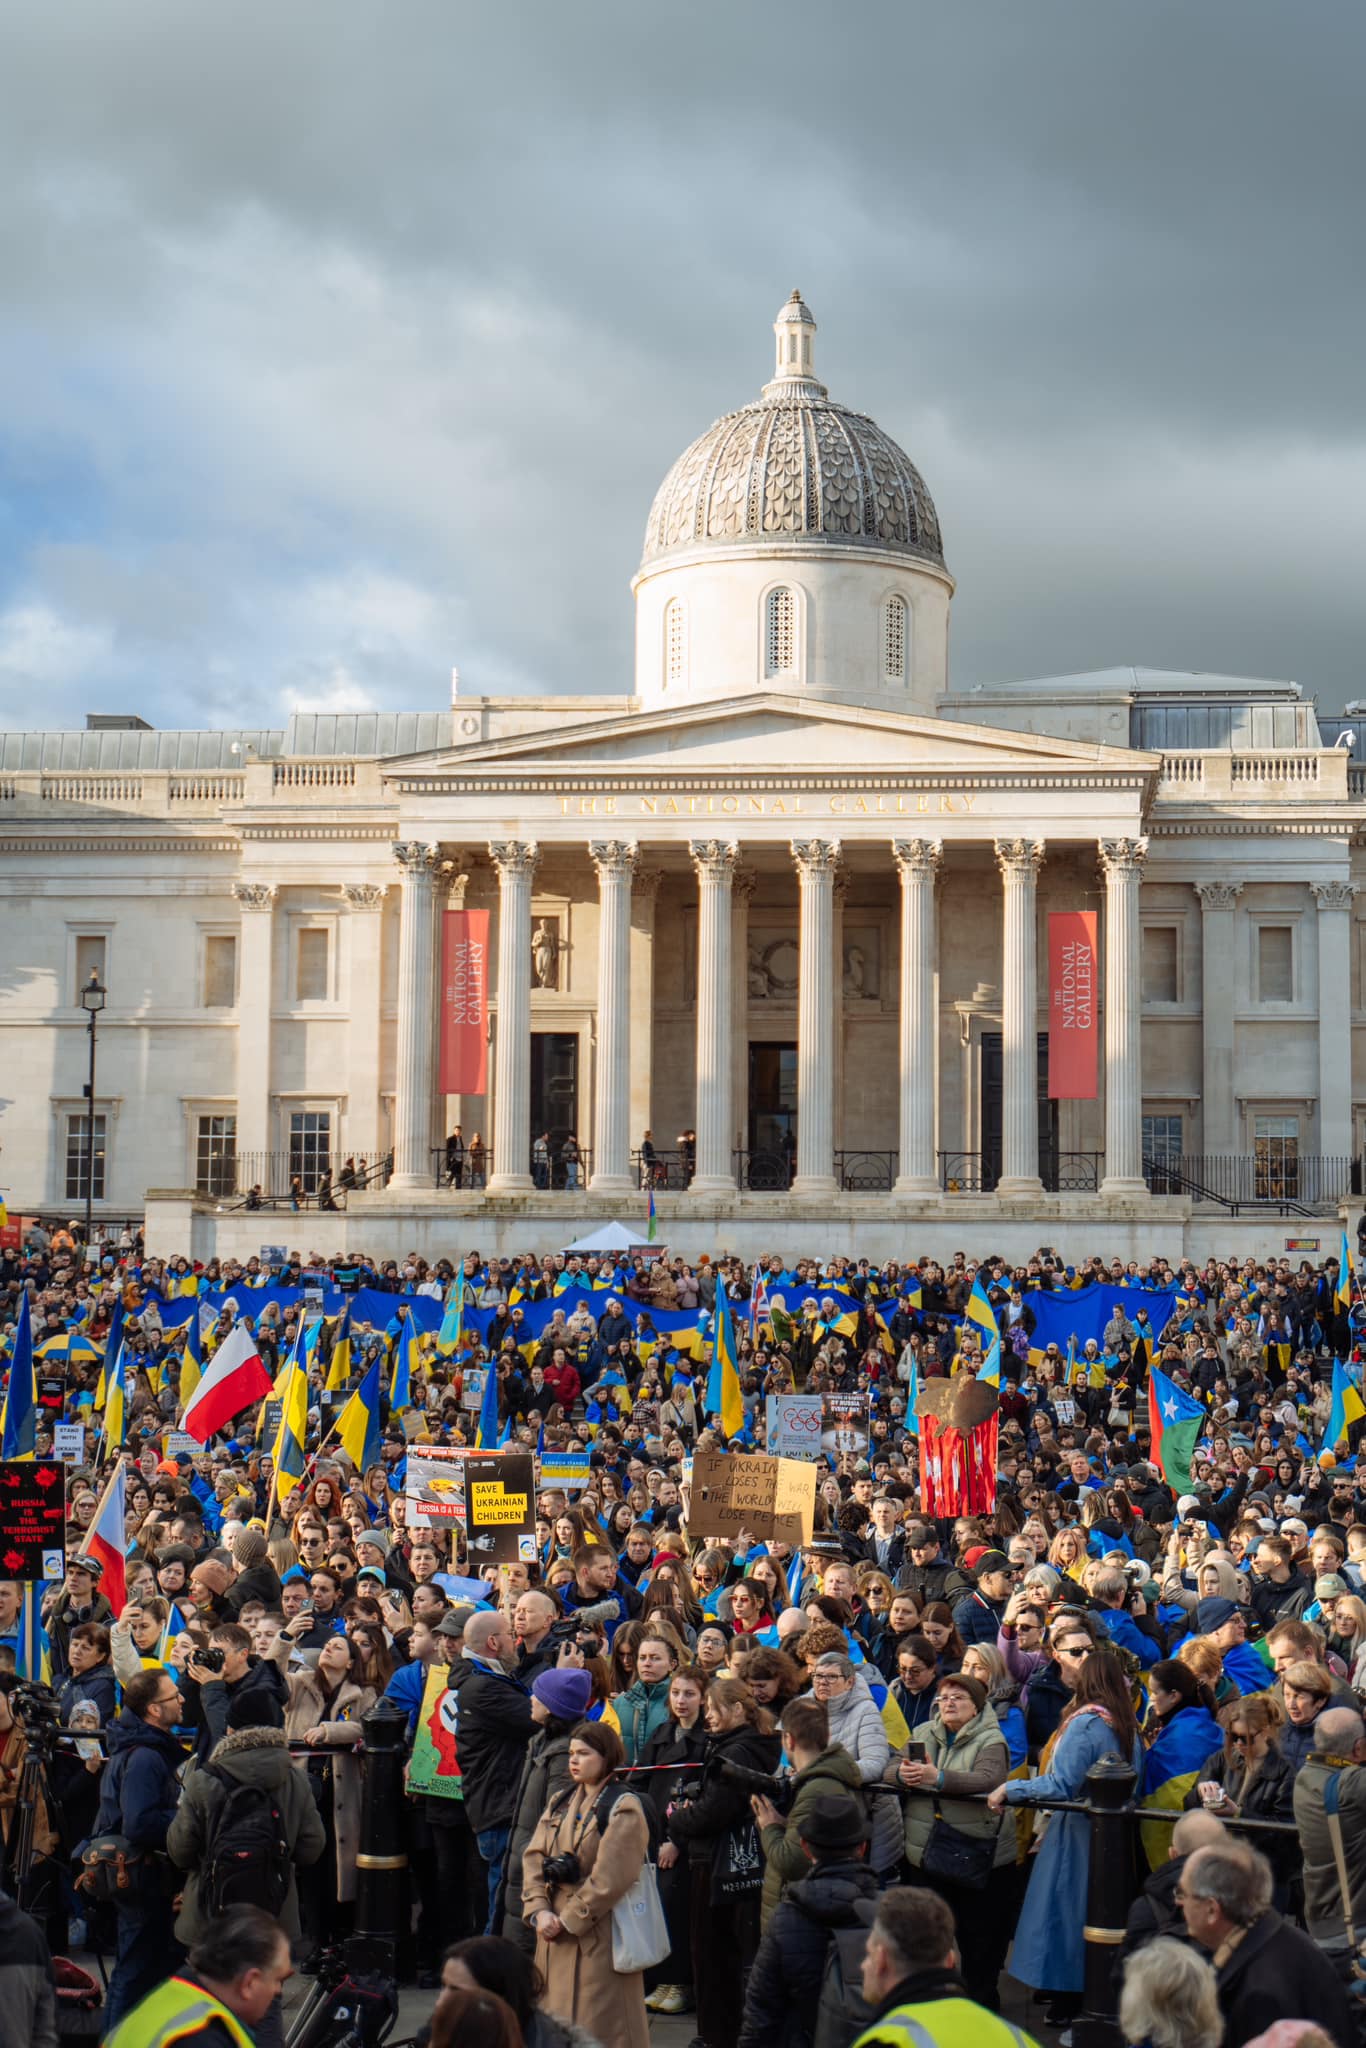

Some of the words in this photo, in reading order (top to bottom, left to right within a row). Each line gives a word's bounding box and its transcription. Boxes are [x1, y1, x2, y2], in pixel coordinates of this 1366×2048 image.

[558, 796, 617, 815] THE
[640, 795, 807, 815] NATIONAL
[829, 795, 977, 814] GALLERY
[454, 939, 468, 1025] NATIONAL
[468, 939, 483, 1025] GALLERY
[1062, 942, 1075, 1028] NATIONAL
[1077, 943, 1091, 1029] GALLERY
[708, 1459, 724, 1472] IF
[729, 1461, 788, 1476] UKRAINE
[725, 1477, 759, 1488] LOSES
[475, 1485, 497, 1494] SAVE
[11, 1500, 46, 1508] RUSSIA
[476, 1497, 524, 1507] UKRAINIAN
[710, 1492, 729, 1504] THE
[737, 1493, 772, 1507] WORLD
[23, 1508, 33, 1517] IS
[418, 1504, 440, 1513] RUSSIA
[19, 1517, 38, 1525] THE
[476, 1511, 521, 1521] CHILDREN
[718, 1509, 746, 1520] LOSE
[753, 1512, 796, 1528] PEACE
[2, 1526, 55, 1535] TERRORIST
